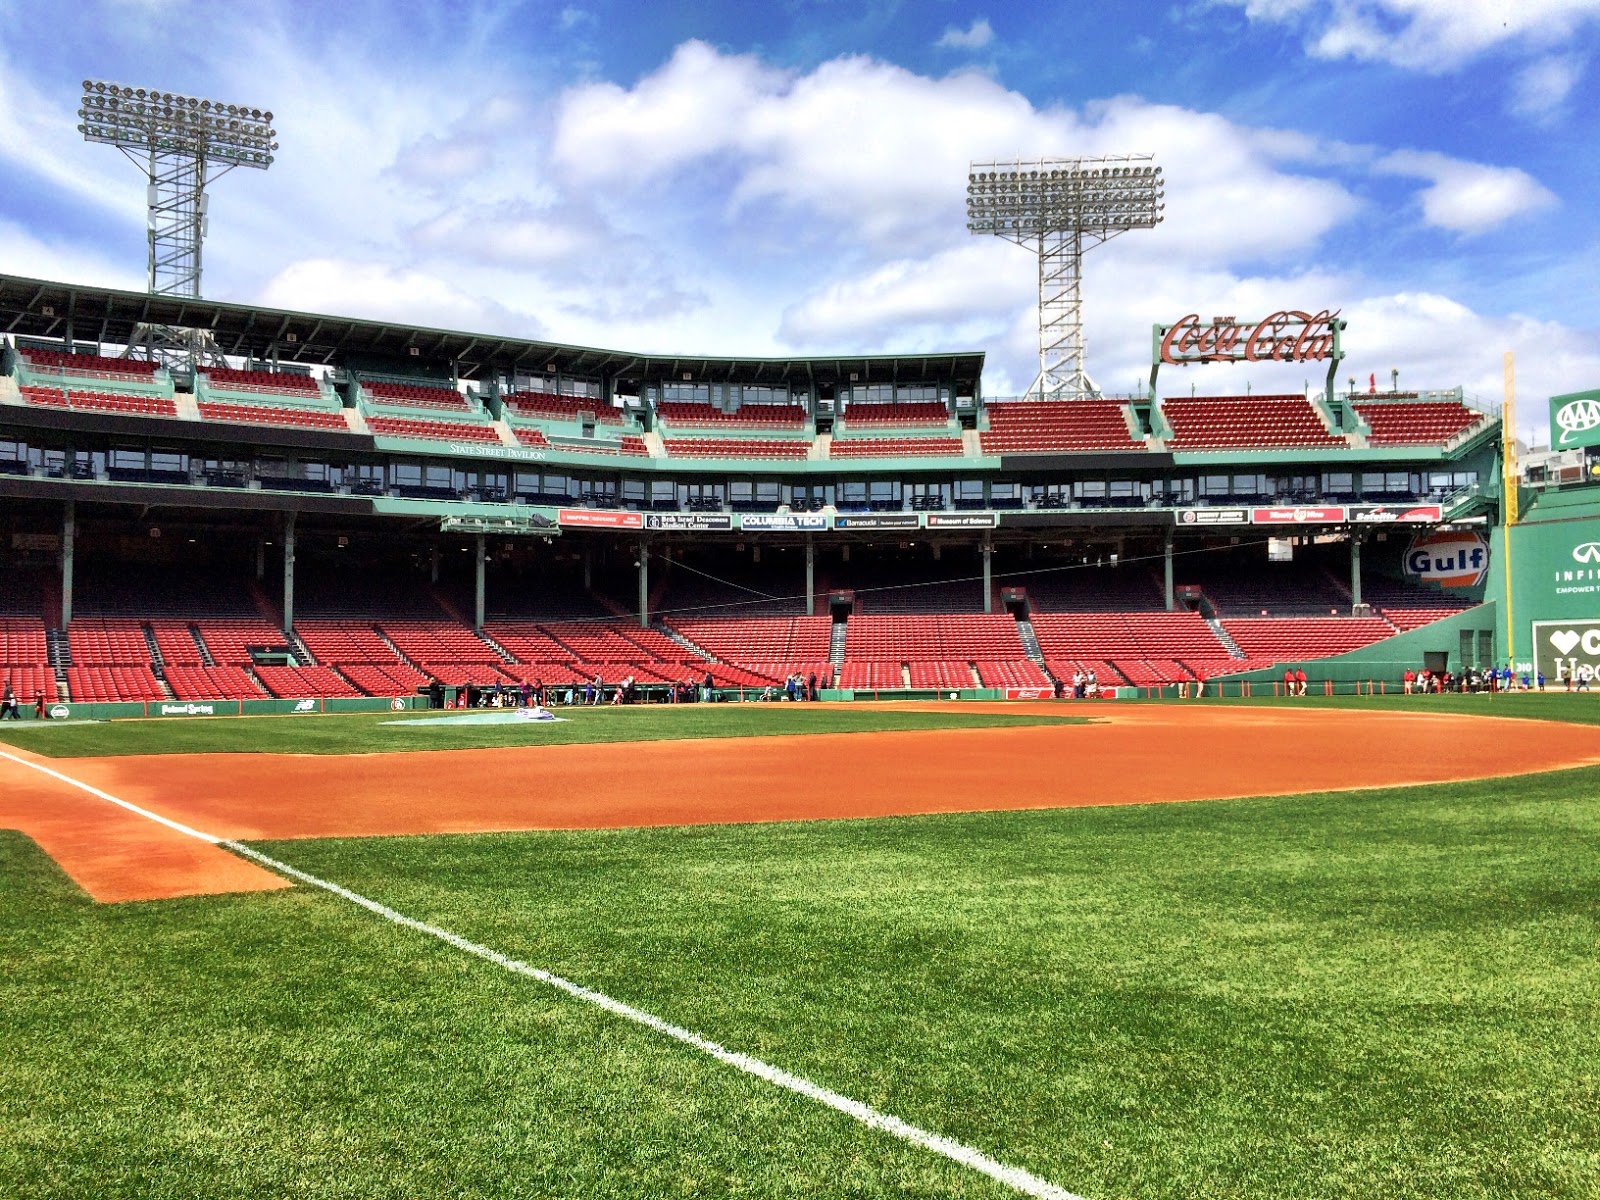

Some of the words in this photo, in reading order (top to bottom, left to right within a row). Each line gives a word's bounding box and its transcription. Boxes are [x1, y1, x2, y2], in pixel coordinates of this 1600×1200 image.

[1560, 401, 1600, 430] AAA
[450, 444, 475, 454] STATE
[475, 447, 505, 457] STREET
[507, 448, 545, 460] PAVILION
[687, 521, 709, 529] Center
[743, 516, 795, 526] COLUMBIA
[796, 517, 825, 526] TECH
[846, 518, 877, 526] Barracuda
[1409, 548, 1483, 572] Gulf
[1556, 585, 1595, 594] EMPOWER
[187, 703, 214, 715] Spring
